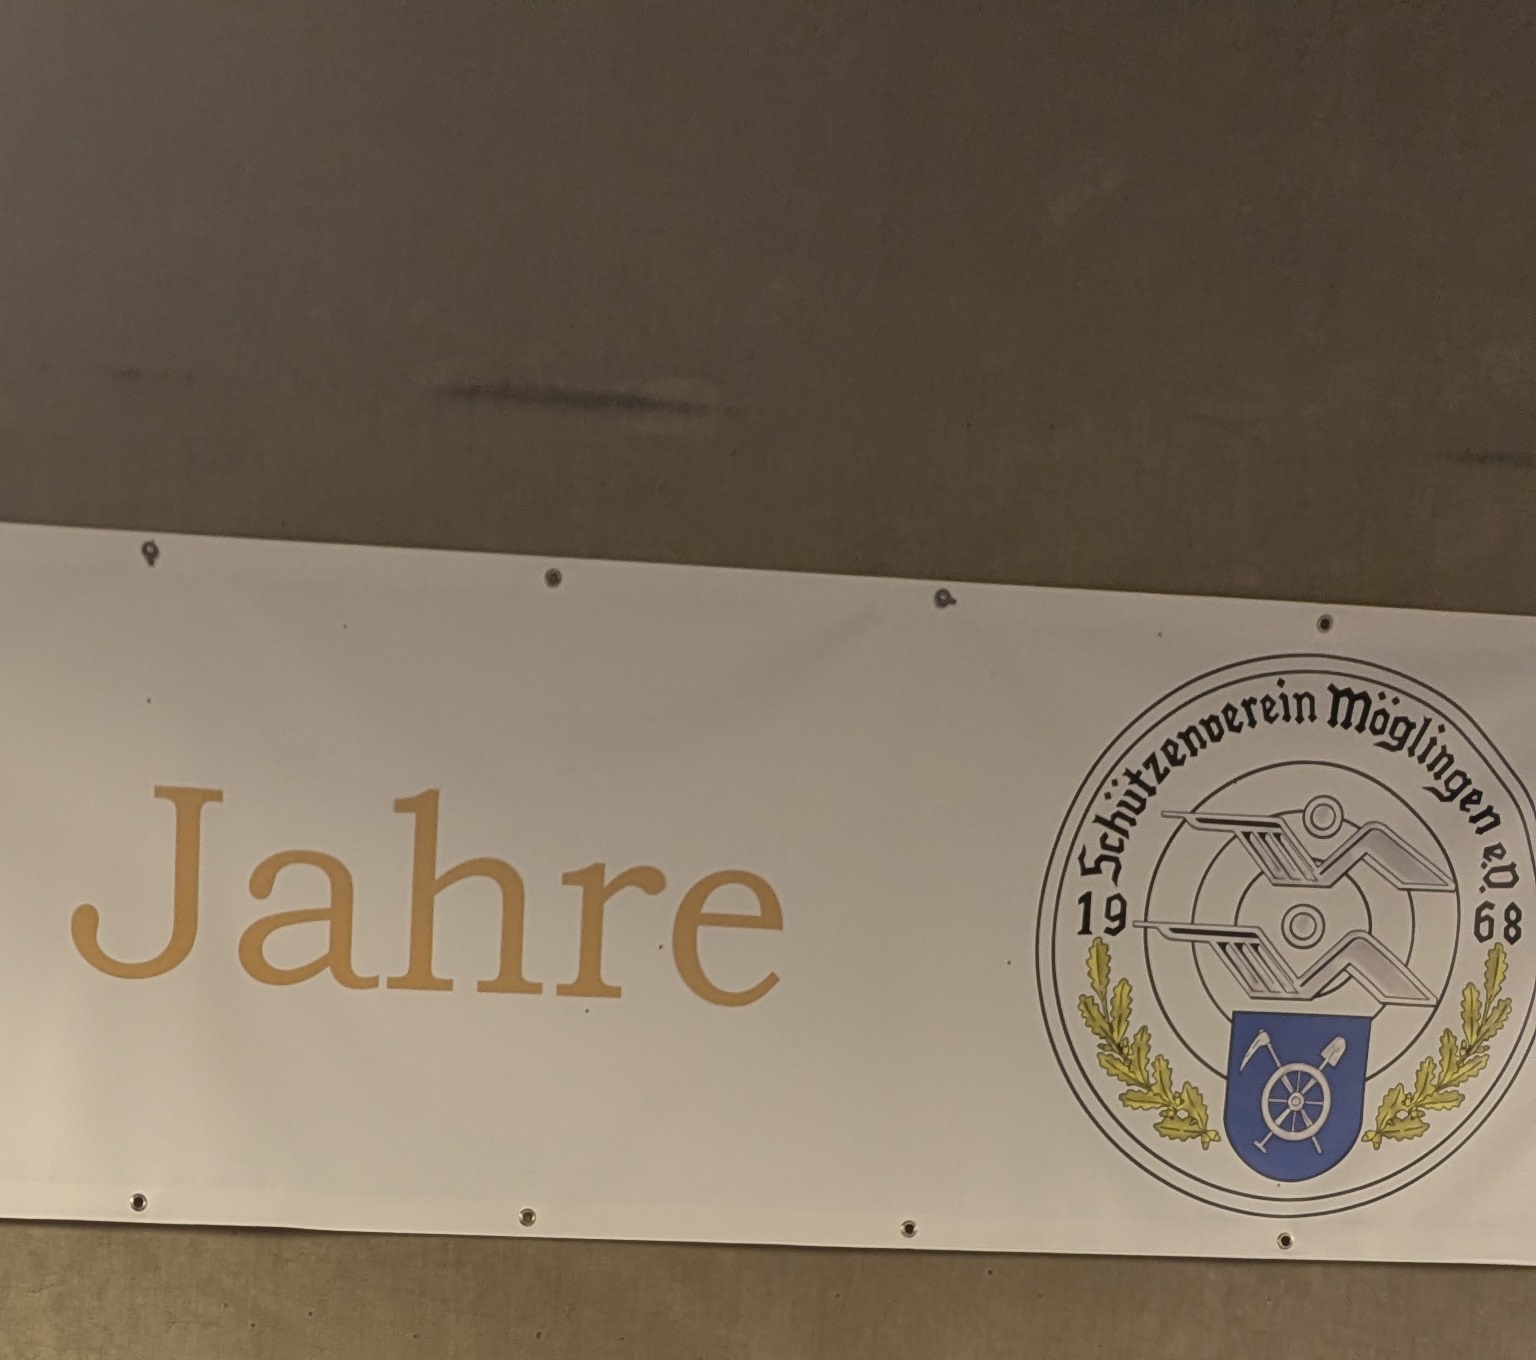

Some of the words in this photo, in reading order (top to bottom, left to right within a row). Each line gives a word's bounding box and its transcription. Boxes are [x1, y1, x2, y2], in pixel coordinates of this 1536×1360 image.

[1079, 678, 1318, 888] Schützenverein
[1326, 681, 1502, 837] Möglingen
[71, 785, 785, 1008] Jahre
[1076, 890, 1128, 937] 19
[1472, 901, 1523, 946] 68
